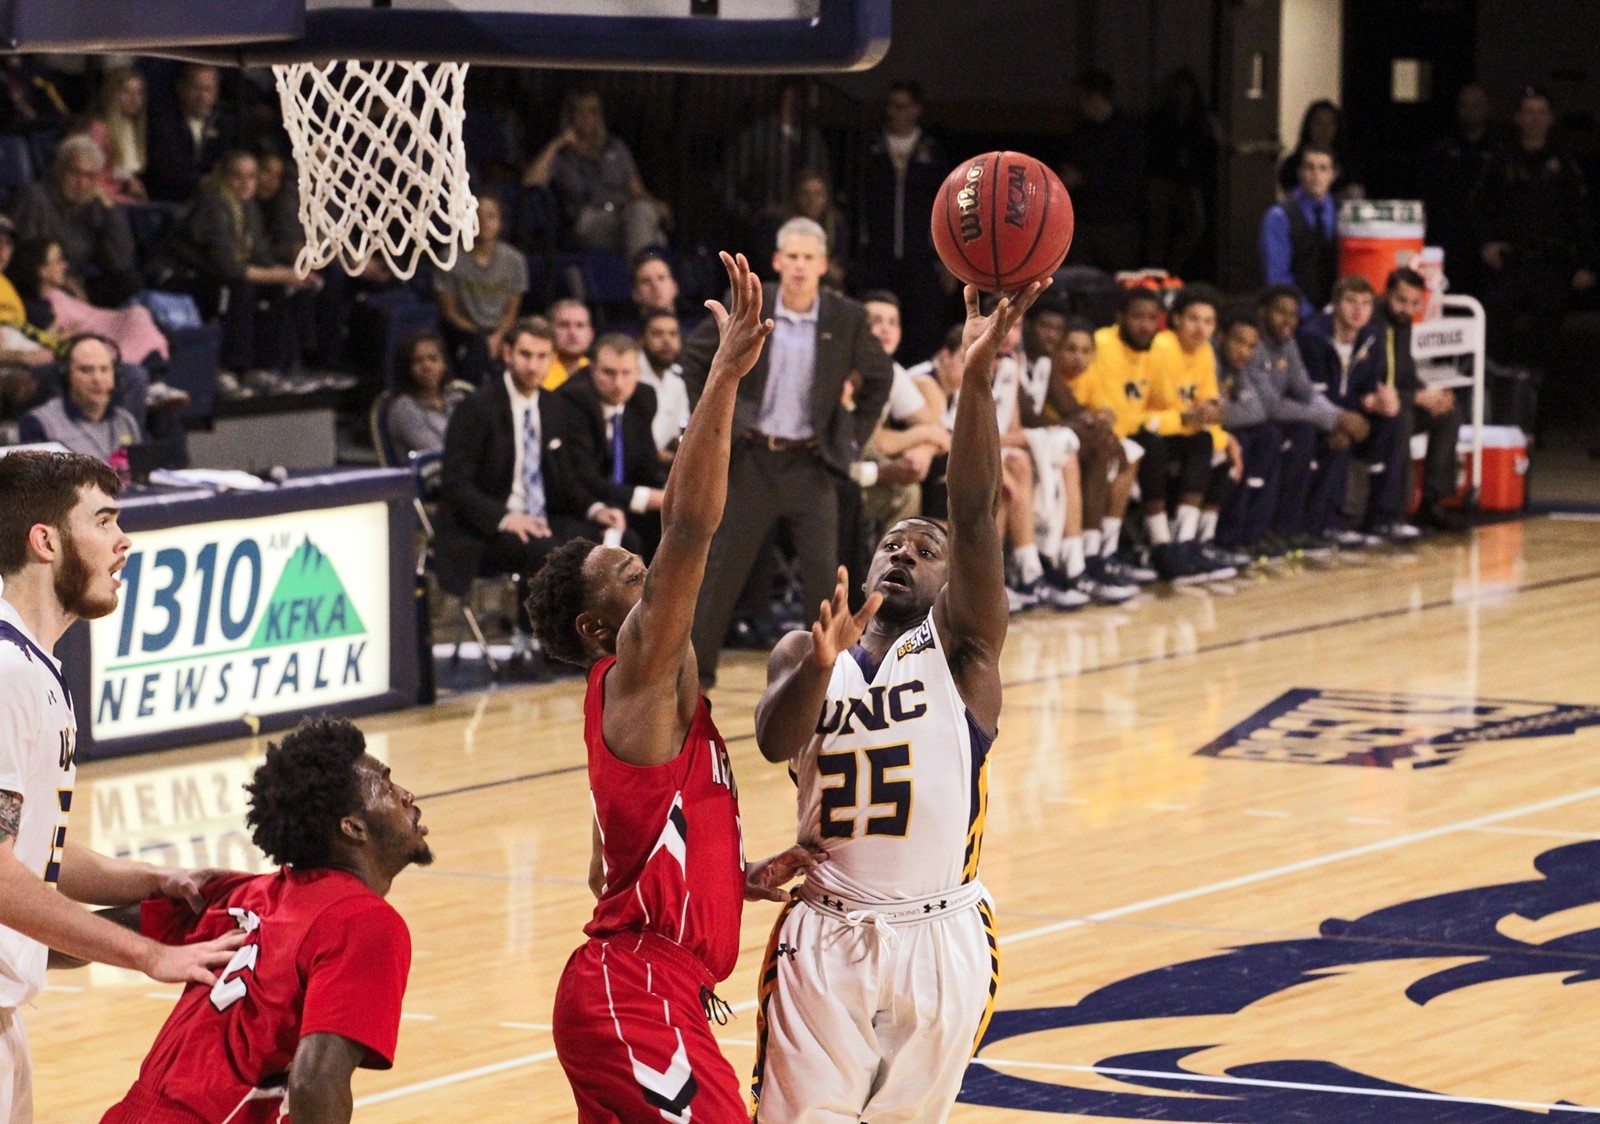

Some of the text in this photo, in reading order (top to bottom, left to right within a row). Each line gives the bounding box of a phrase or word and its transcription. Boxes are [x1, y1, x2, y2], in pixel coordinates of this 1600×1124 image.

[1004, 164, 1027, 230] NCAA
[116, 532, 292, 658] 1310 AM
[264, 592, 347, 643] KFKA
[815, 679, 928, 735] UNC
[815, 740, 914, 839] 25
